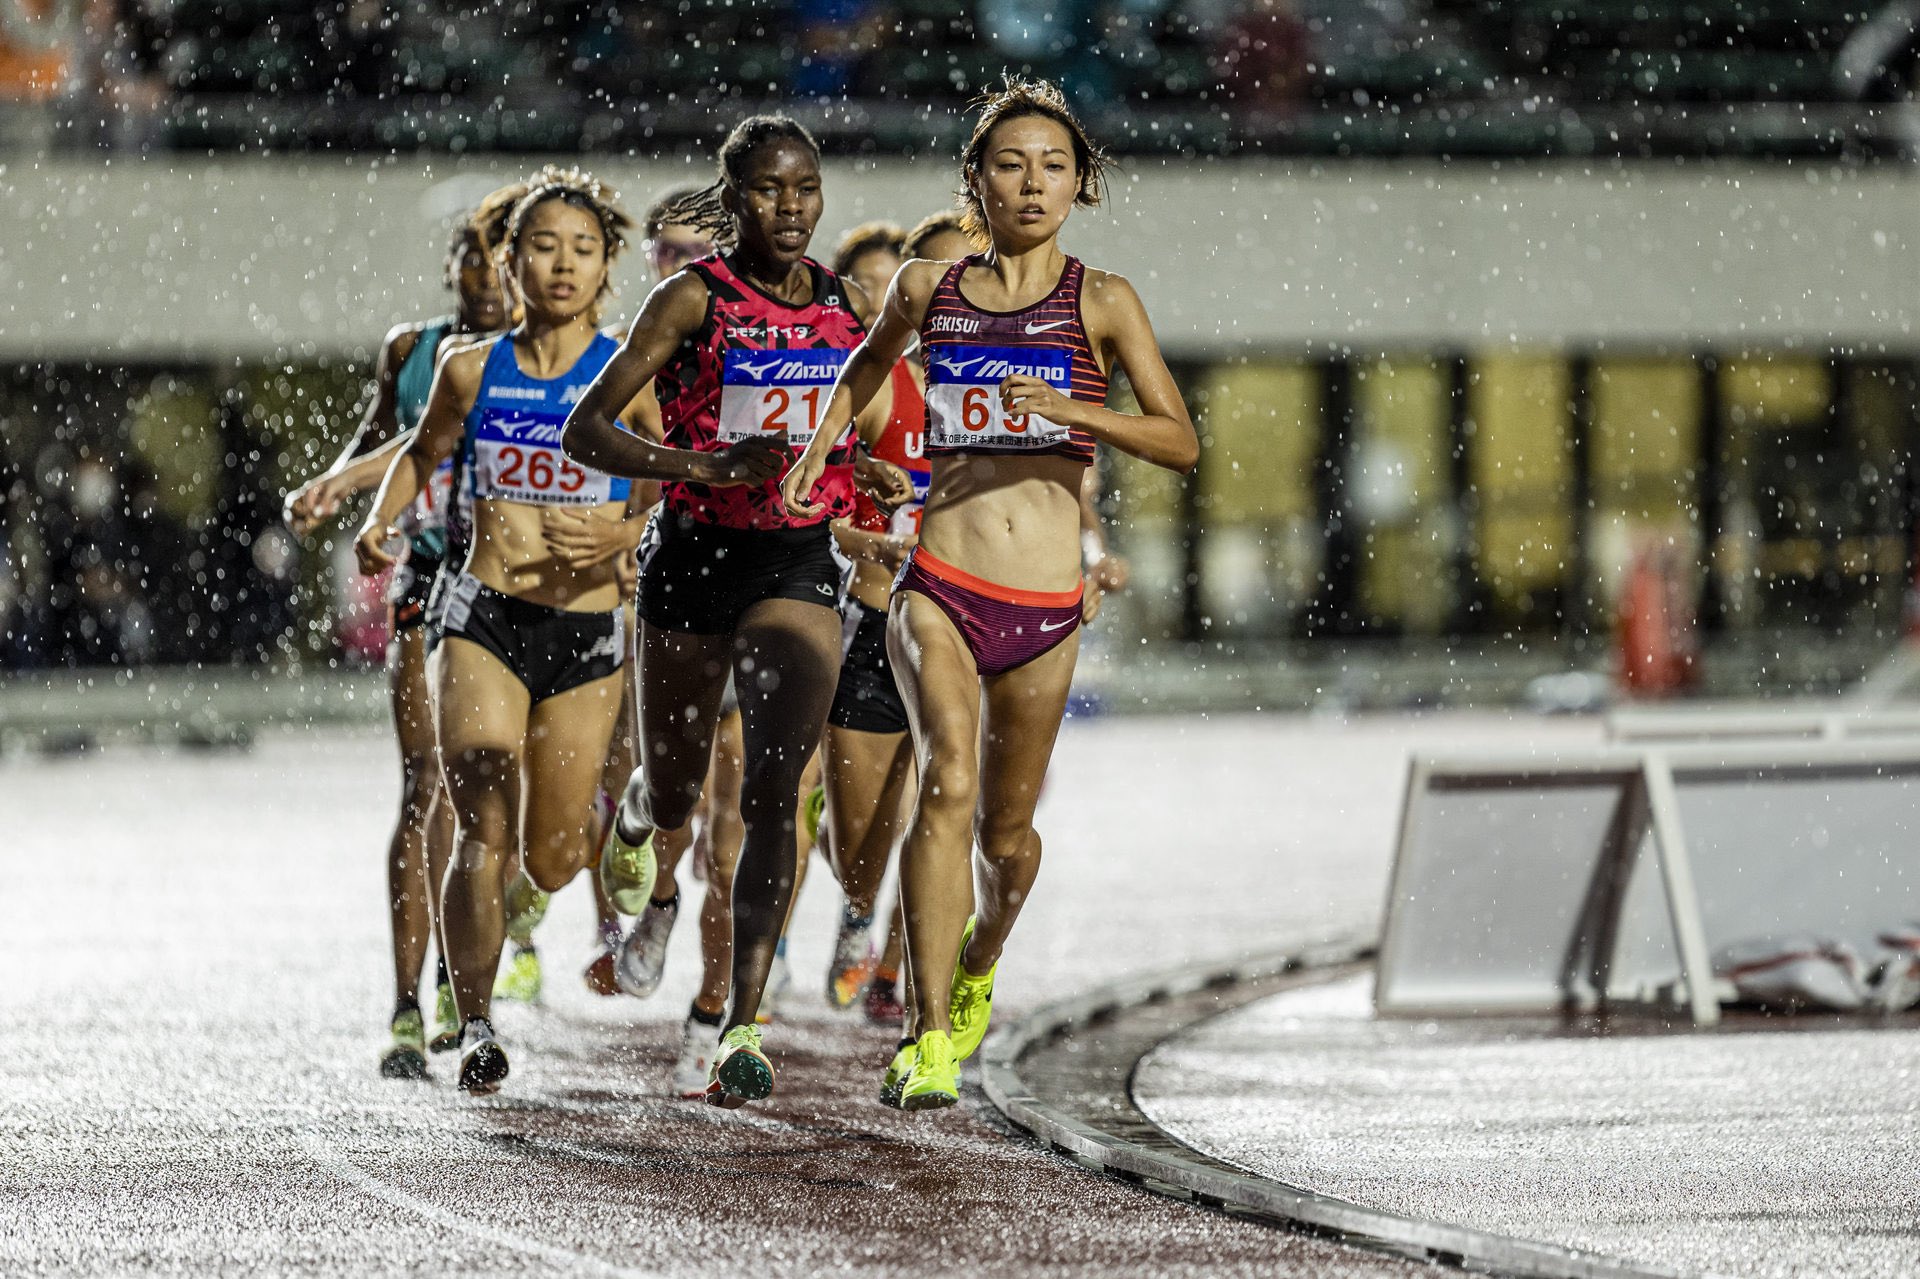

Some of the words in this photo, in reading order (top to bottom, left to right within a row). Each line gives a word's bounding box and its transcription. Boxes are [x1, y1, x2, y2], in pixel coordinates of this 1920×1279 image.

[931, 315, 979, 334] SEKISUI
[774, 360, 842, 380] MIZUN
[761, 387, 820, 431] 21
[497, 446, 586, 492] 265
